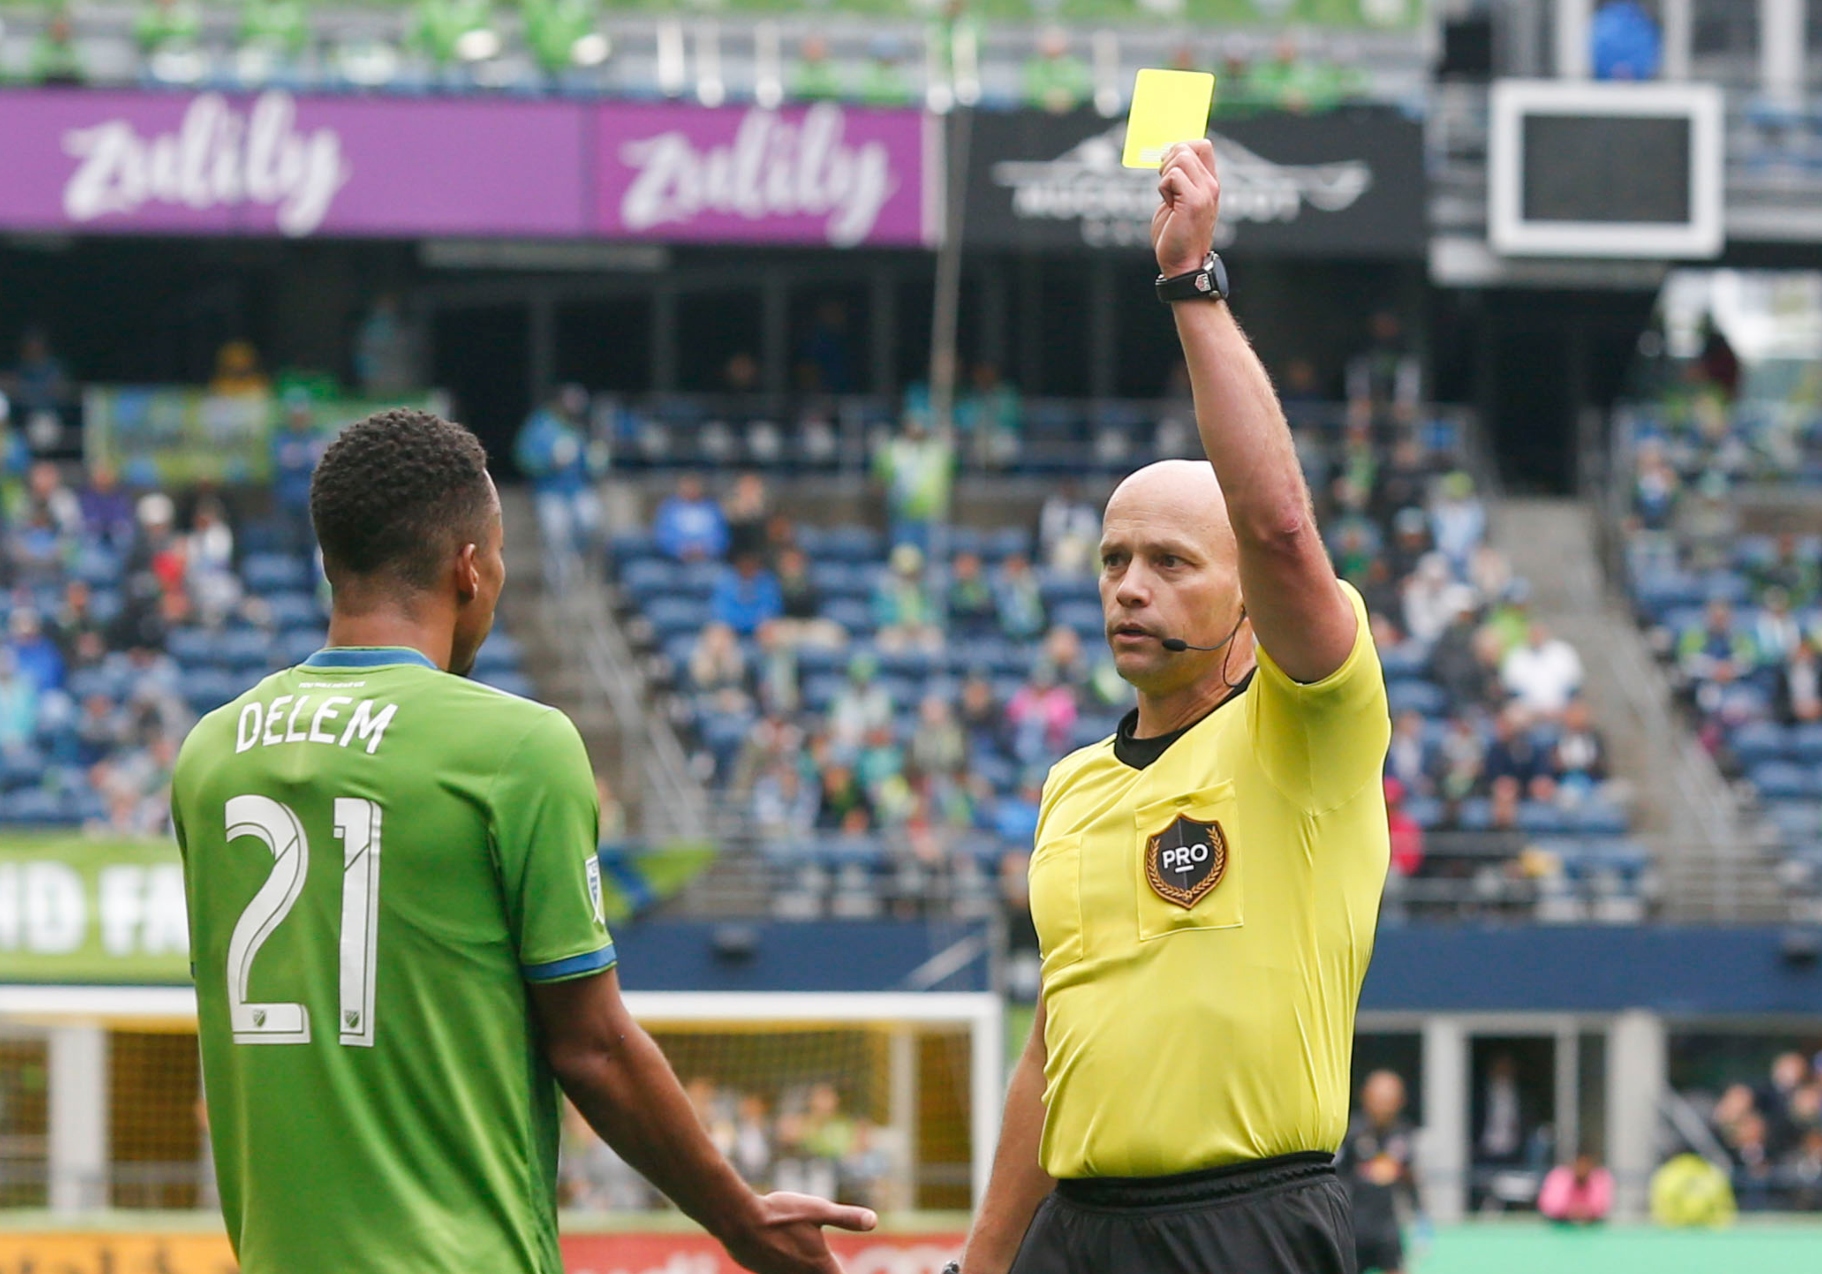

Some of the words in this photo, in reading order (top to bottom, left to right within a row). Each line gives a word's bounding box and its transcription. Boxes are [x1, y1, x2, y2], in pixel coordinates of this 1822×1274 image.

[235, 694, 399, 754] DELEM
[1162, 843, 1209, 869] PRO
[225, 795, 383, 1046] 21
